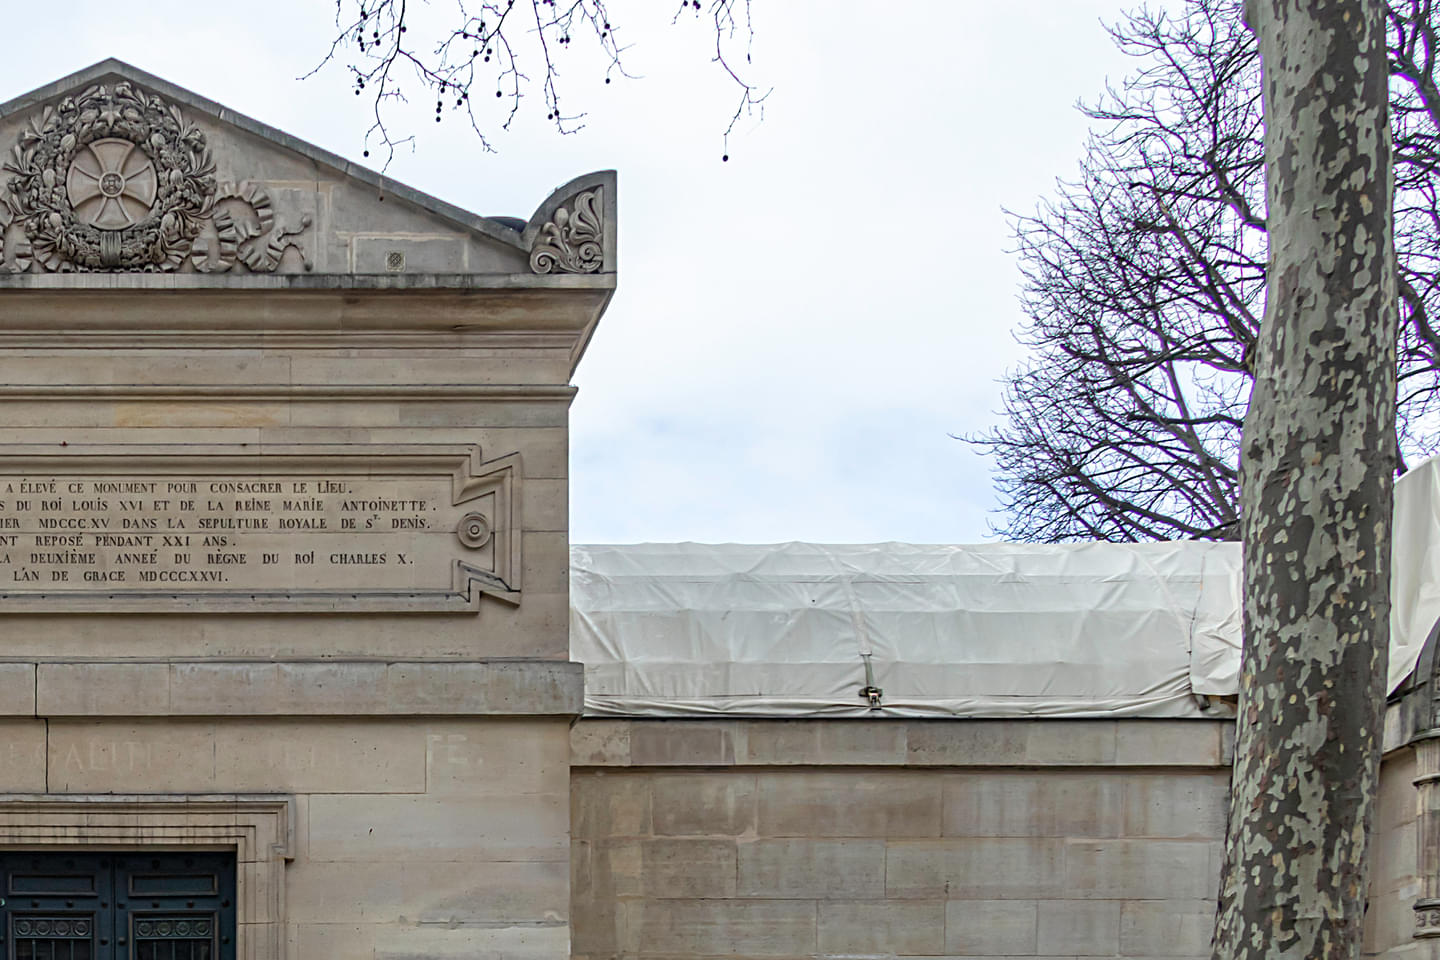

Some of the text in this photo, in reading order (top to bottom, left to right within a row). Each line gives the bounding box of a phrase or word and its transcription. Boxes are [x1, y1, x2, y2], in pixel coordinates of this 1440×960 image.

[5, 482, 15, 494] A
[20, 478, 57, 494] ÉLEVÉ
[67, 482, 84, 494] CE
[93, 482, 158, 494] MONUMENT
[167, 482, 198, 494] POUR
[209, 482, 282, 494] CONSACRER
[292, 482, 308, 494] LE
[16, 499, 32, 512] DU
[72, 496, 109, 512] LOUIS
[119, 499, 143, 512] XVI
[153, 499, 171, 512] ET
[180, 499, 195, 512] DE
[207, 499, 224, 512] LA
[122, 517, 158, 529] DANS
[167, 517, 186, 529] LA
[198, 517, 269, 529] SEPULTURE
[278, 517, 328, 529] ROYALE
[340, 517, 357, 529] DE
[35, 531, 84, 547] REPOSÉ
[95, 535, 154, 547] PENDANT
[162, 535, 190, 547] XXI
[30, 548, 96, 565] DEUXIÈME
[174, 553, 191, 565] DU
[207, 548, 247, 565] RÈGNE
[262, 553, 279, 565] DU
[329, 553, 387, 565] CHARLES
[51, 570, 69, 582] DE
[83, 570, 126, 582] GRACE
